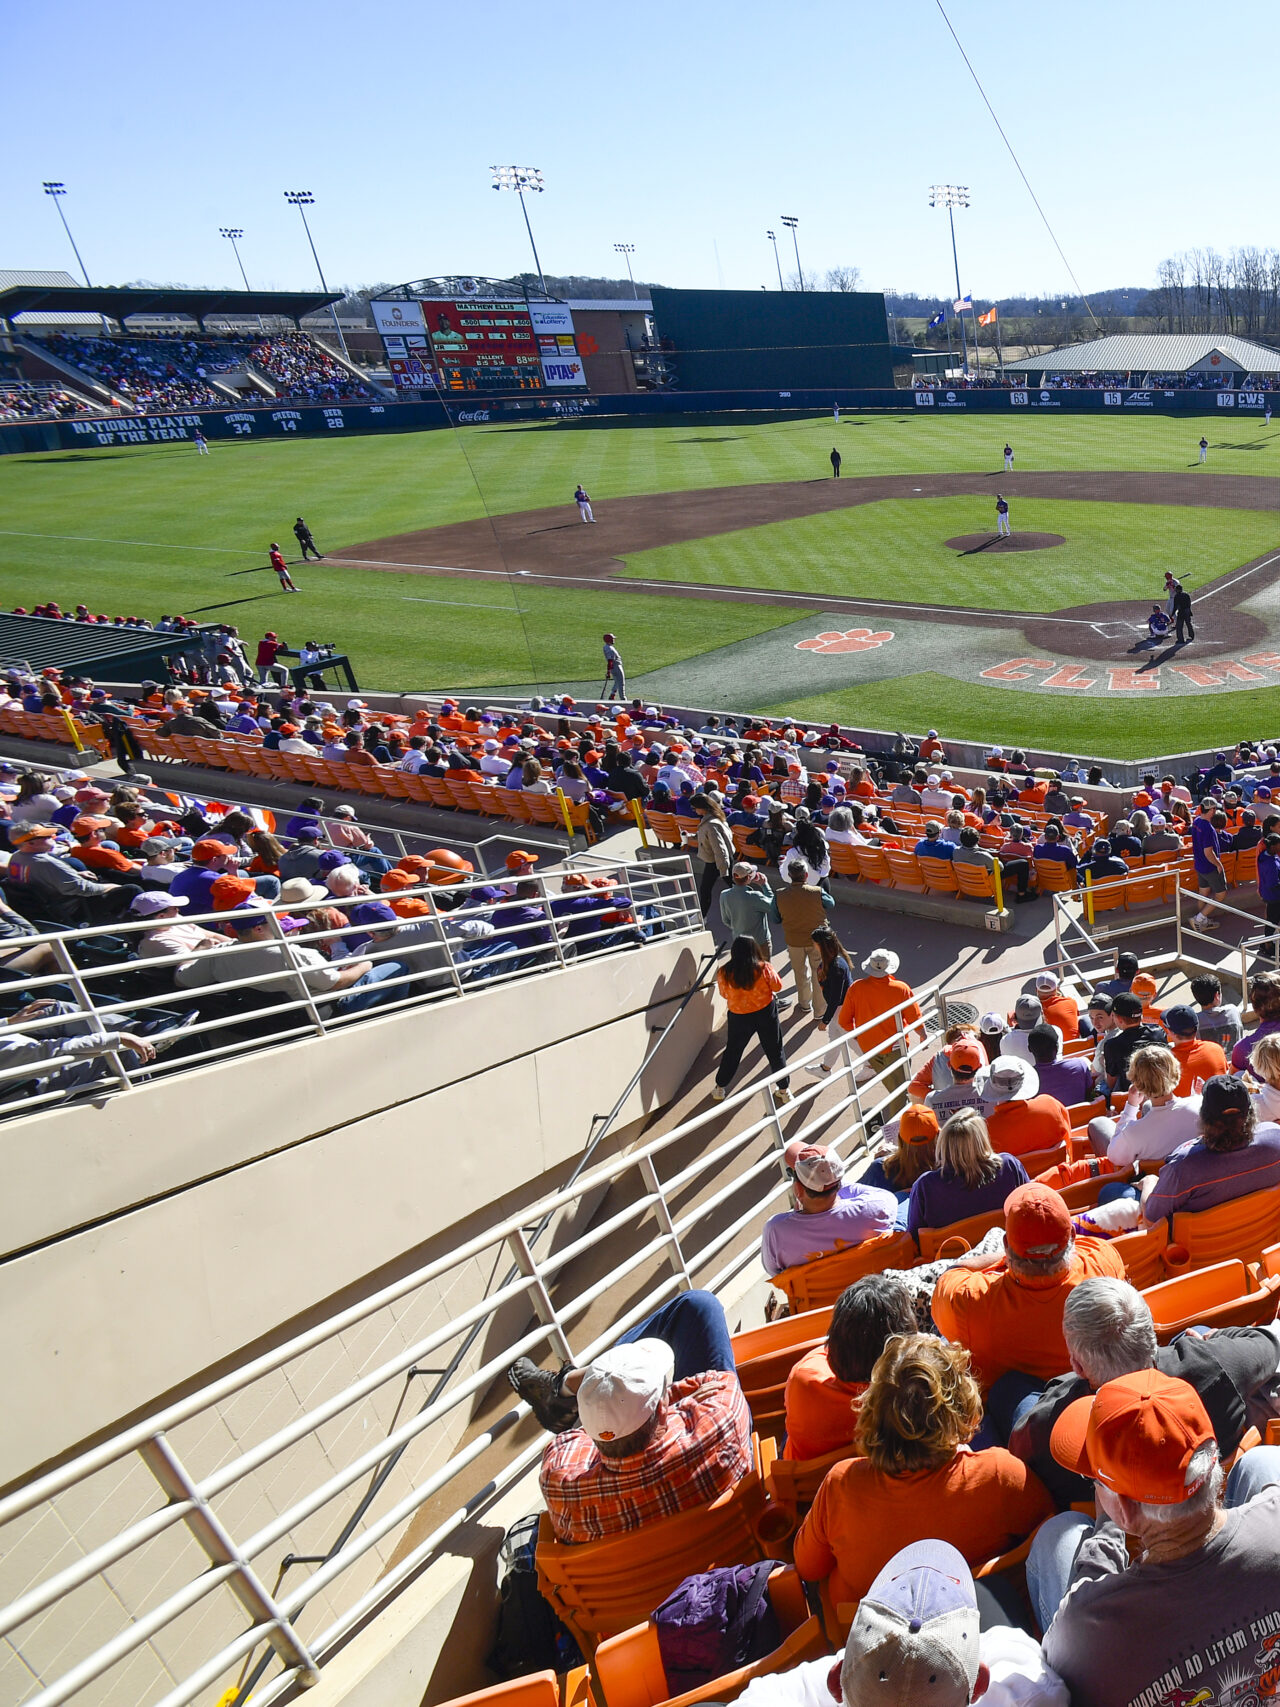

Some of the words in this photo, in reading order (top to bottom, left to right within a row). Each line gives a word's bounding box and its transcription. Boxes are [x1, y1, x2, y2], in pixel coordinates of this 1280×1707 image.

[381, 319, 420, 327] FOUNDERS
[516, 356, 527, 364] 88
[403, 361, 424, 374] 12
[400, 373, 434, 385] CWS
[1127, 392, 1151, 400] ACC
[1238, 393, 1265, 404] CWS
[224, 412, 257, 424] BENSON
[271, 411, 302, 421] GREENE
[322, 408, 344, 417] BEER
[458, 409, 490, 422] Coca-Cola
[71, 418, 148, 434] NATIONAL
[147, 415, 203, 429] PLAYER
[233, 423, 252, 434] 34
[280, 420, 297, 431] 14
[327, 417, 345, 429] 28
[97, 432, 116, 445] OF
[117, 430, 148, 443] THE
[149, 427, 189, 441] YEAR
[1185, 1653, 1203, 1680] AD
